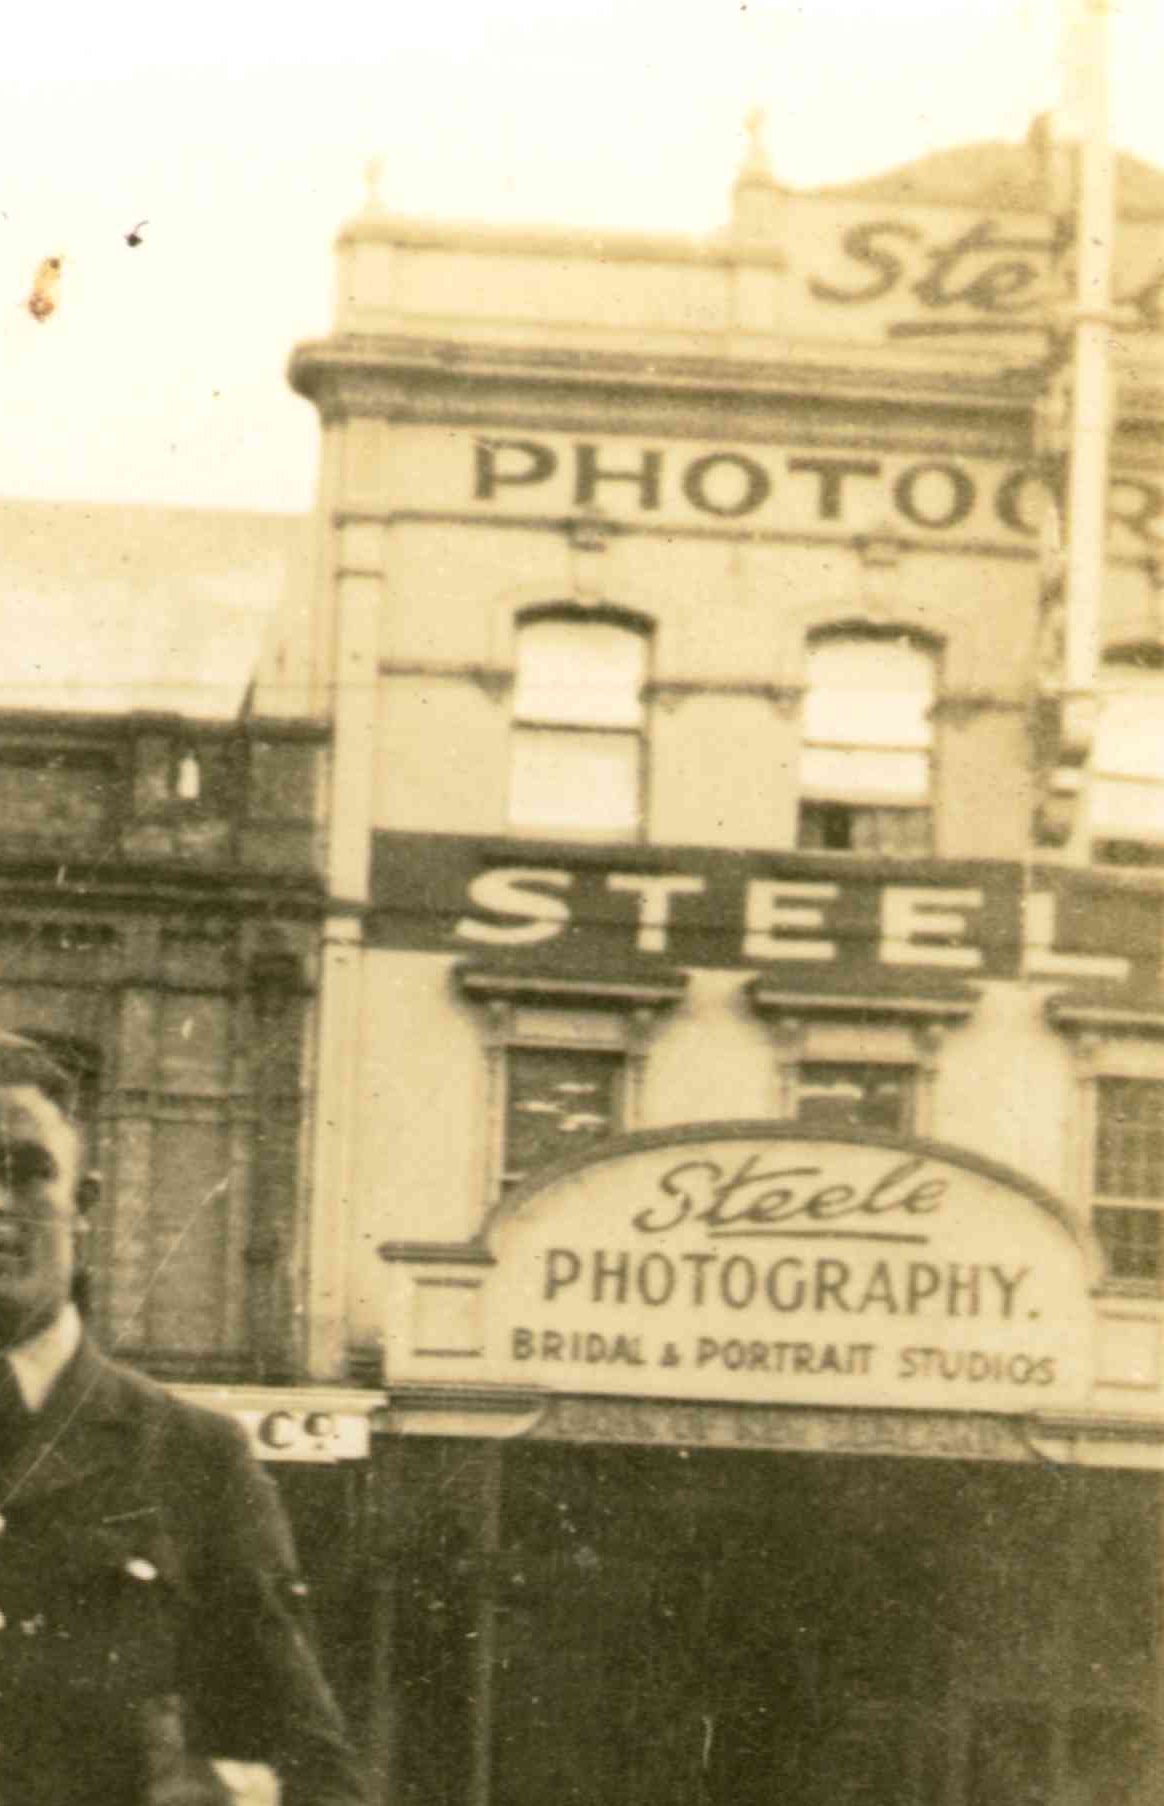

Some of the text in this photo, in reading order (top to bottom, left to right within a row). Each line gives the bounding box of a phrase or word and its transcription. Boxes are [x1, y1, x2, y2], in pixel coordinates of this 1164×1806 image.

[456, 868, 1131, 978] STEEL
[633, 1157, 948, 1233] Steele
[543, 1247, 1042, 1321] PHOTOGRAPHY.
[511, 1327, 1056, 1387] BRIDAL & PORTRAIT STUDIOS
